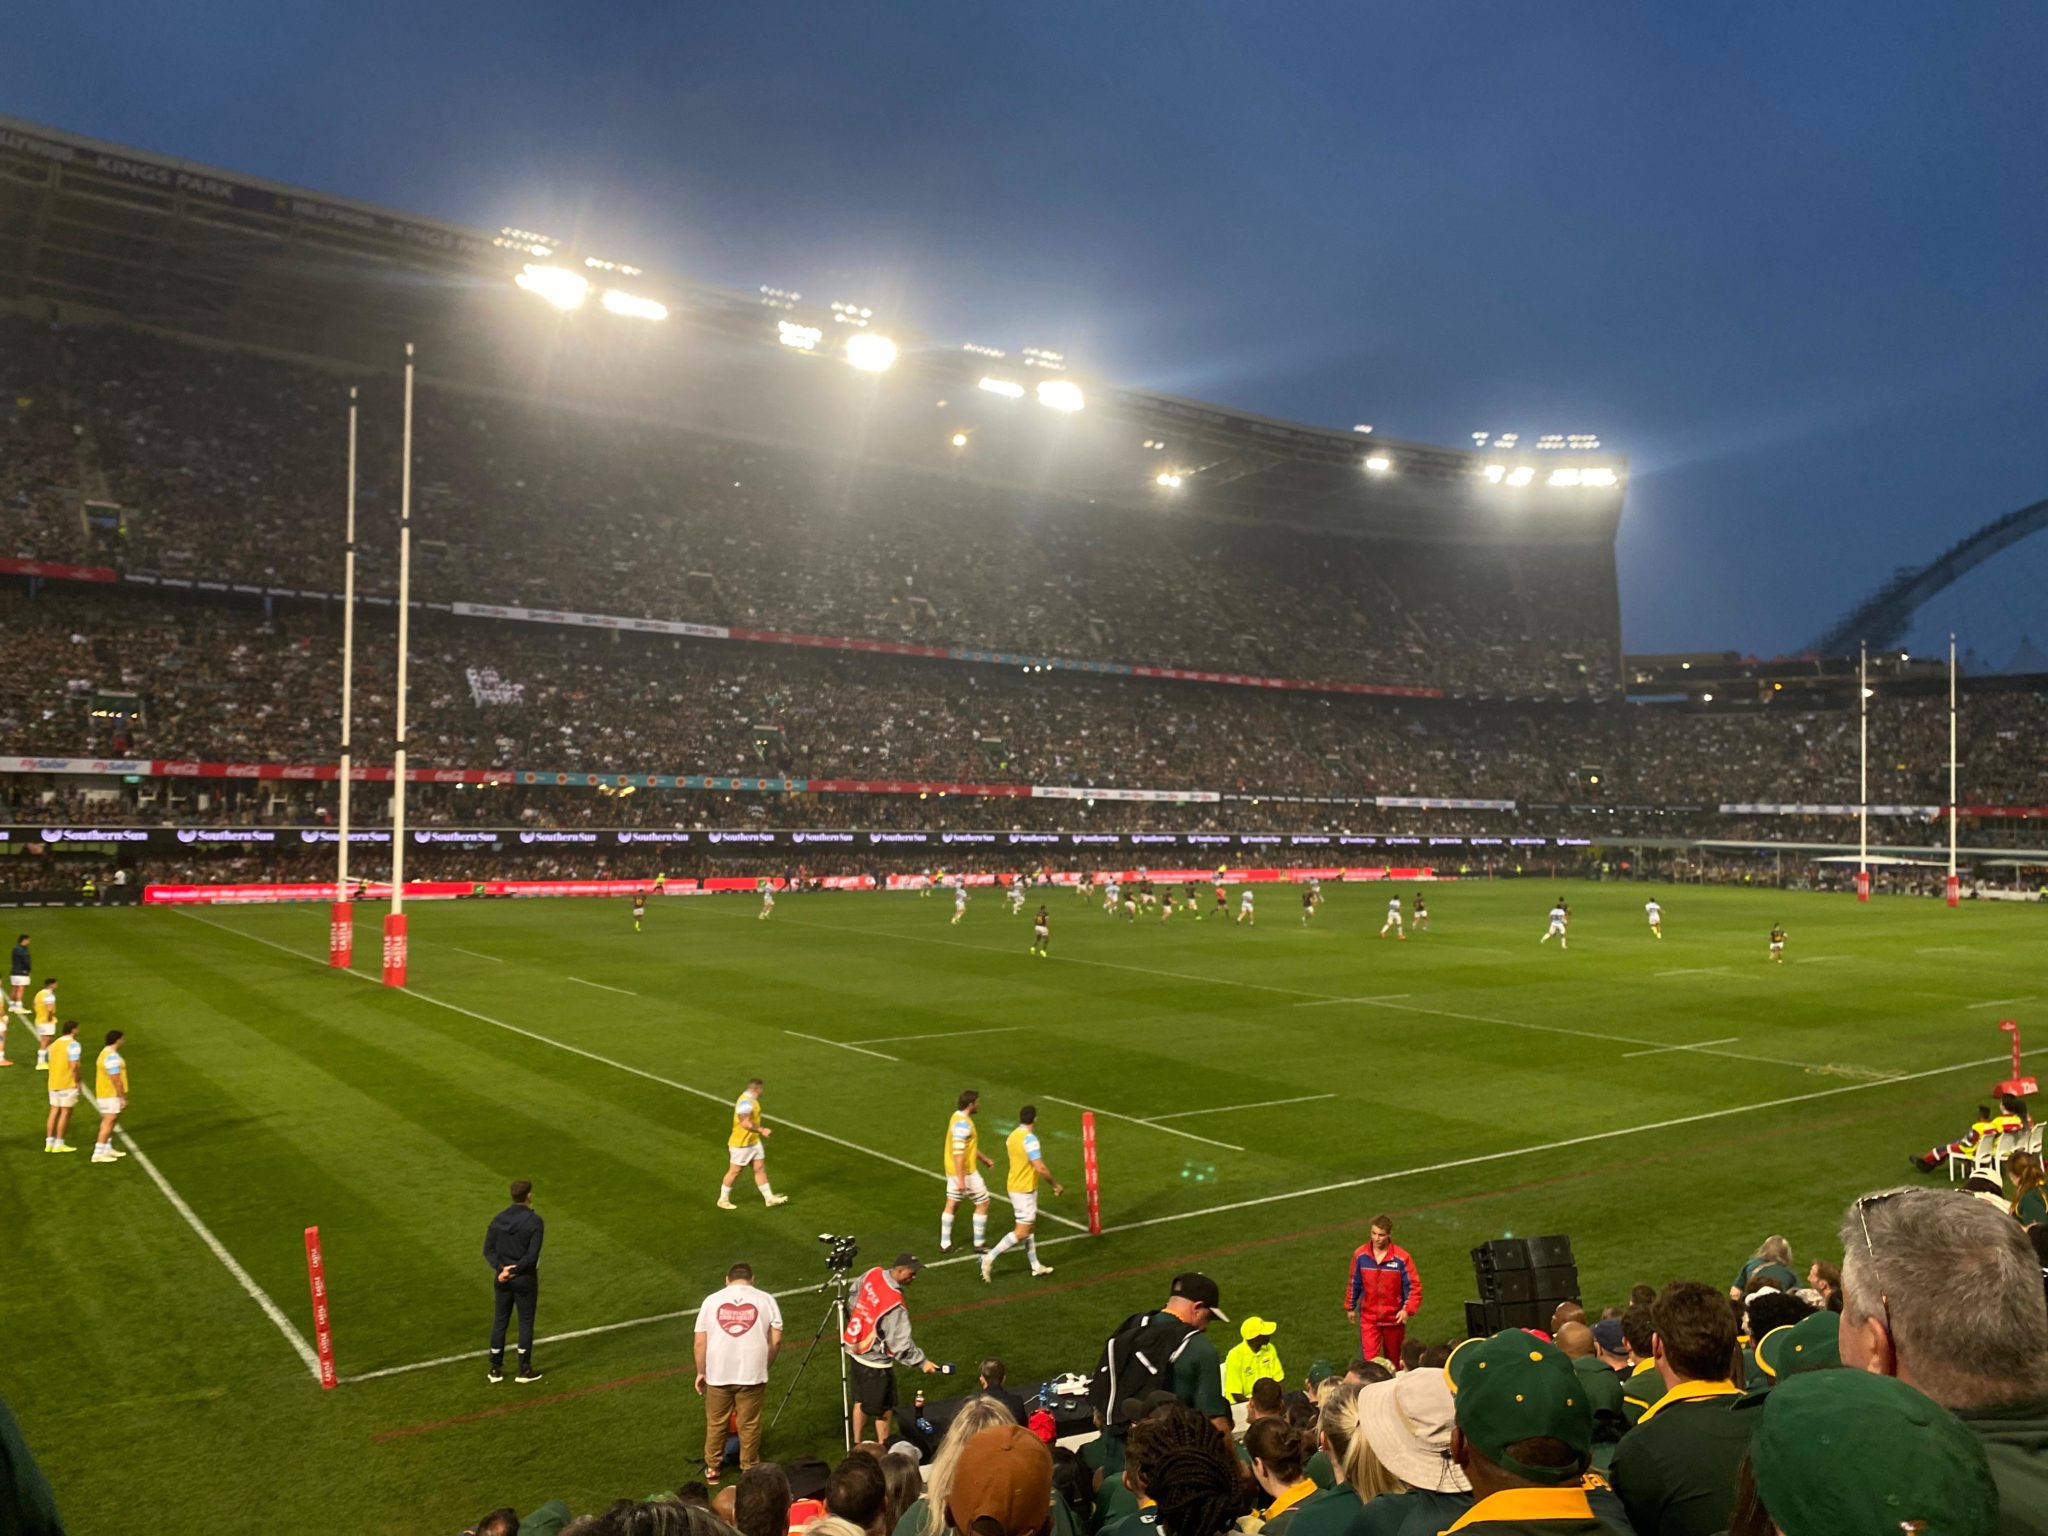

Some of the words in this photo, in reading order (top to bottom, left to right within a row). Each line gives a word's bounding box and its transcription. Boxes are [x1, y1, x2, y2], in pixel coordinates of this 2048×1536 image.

[97, 156, 169, 185] KINGS
[175, 172, 233, 198] PARK
[63, 830, 122, 841] Southern
[123, 831, 148, 841] Sun
[197, 830, 252, 841] Southern
[253, 831, 275, 841] Sun
[319, 831, 368, 841] Souern
[369, 832, 390, 841] Sun
[431, 831, 477, 842] Southern
[478, 832, 497, 842] Sun
[535, 831, 577, 841] Southern
[578, 832, 597, 841] Sun
[632, 831, 672, 841] Southern
[673, 832, 689, 841] Sun
[722, 832, 759, 841] Southern
[760, 833, 774, 841] Sun
[338, 921, 348, 952] CASTLE
[392, 935, 402, 968] CASTLE
[311, 1248, 319, 1268] CASTLE
[314, 1276, 322, 1297] CASTLE
[847, 1317, 862, 1336] 3
[320, 1332, 329, 1354] CASTLE
